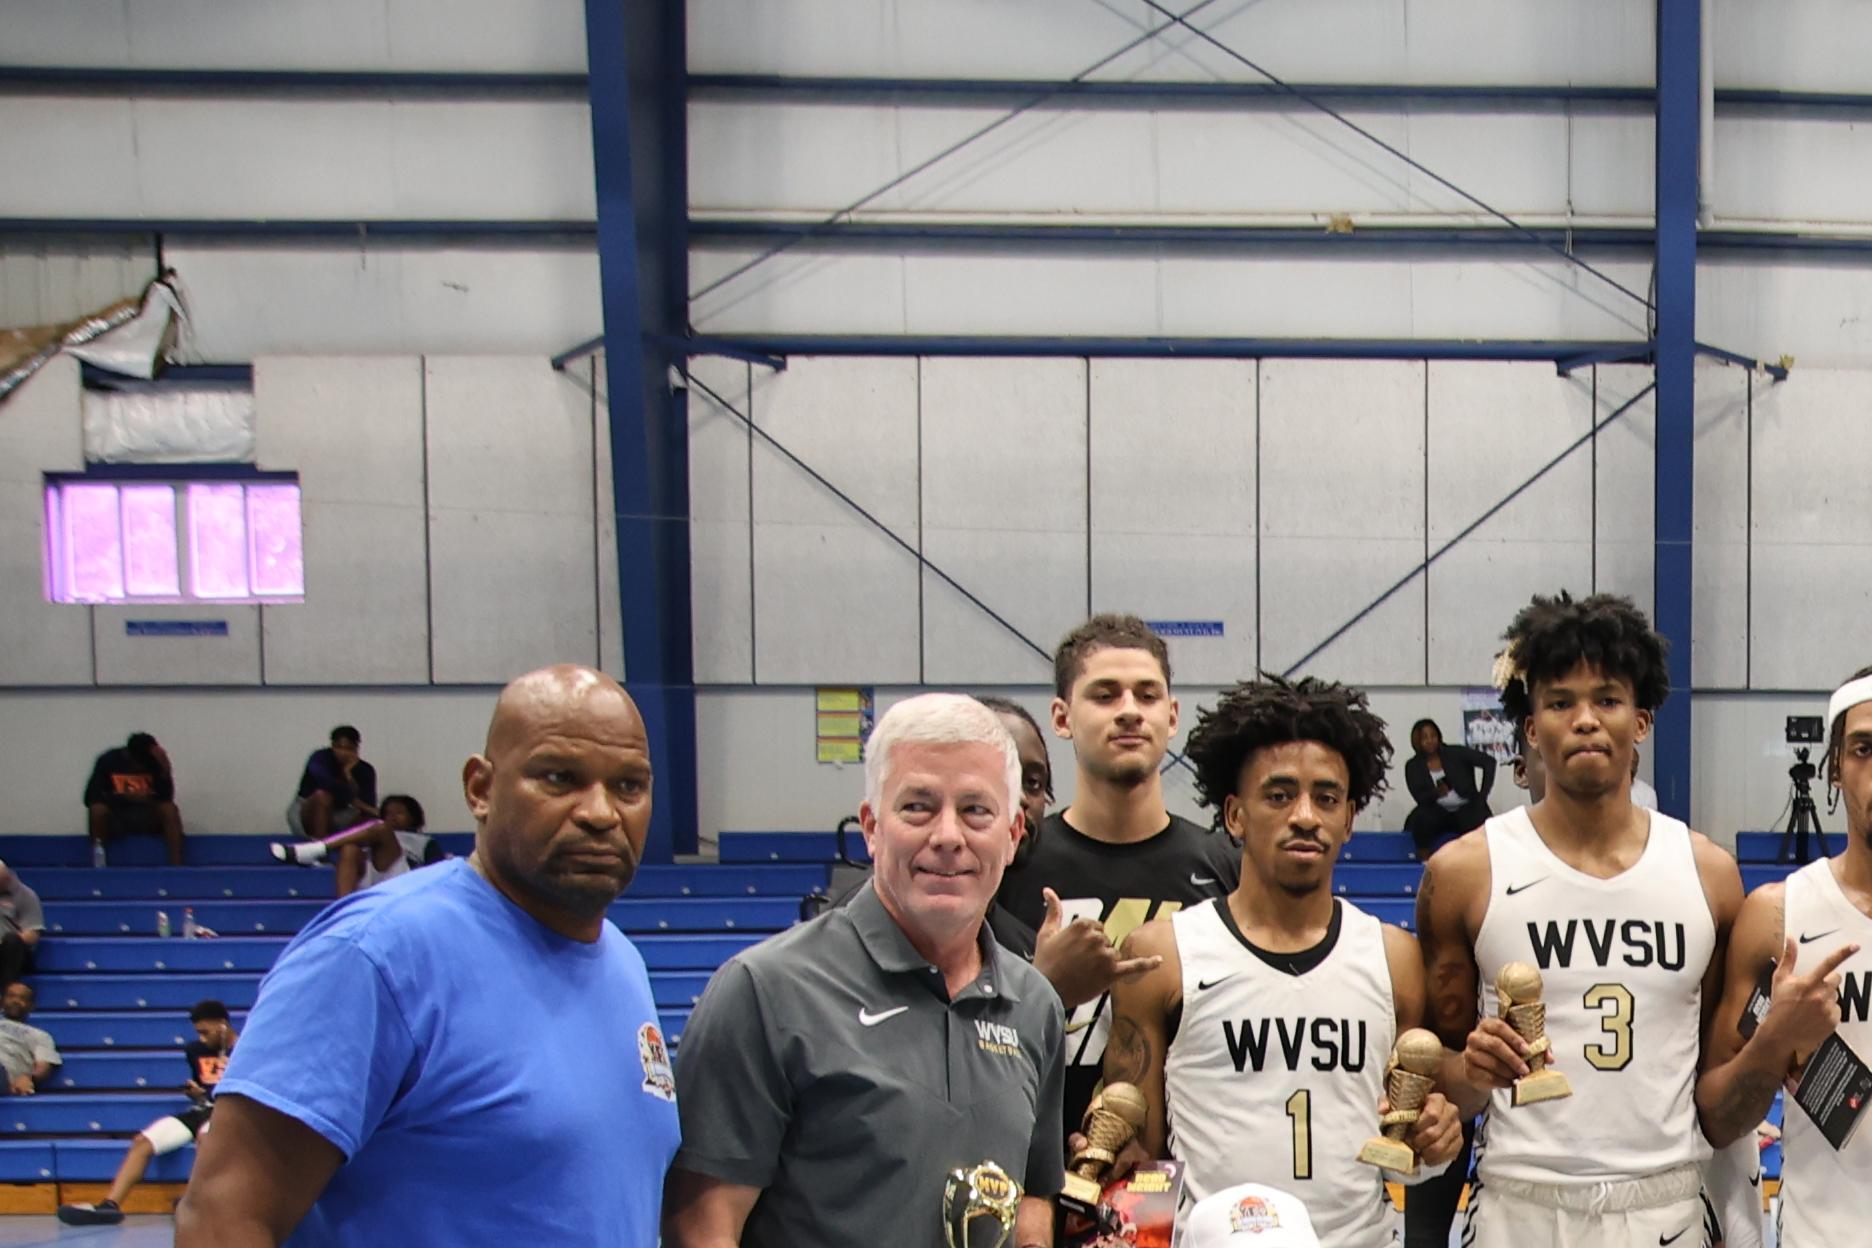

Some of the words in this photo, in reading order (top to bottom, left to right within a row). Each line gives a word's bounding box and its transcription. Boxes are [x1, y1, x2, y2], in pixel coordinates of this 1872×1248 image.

[1527, 919, 1686, 972] WVSU
[974, 1019, 1019, 1048] WVSU
[1222, 1017, 1366, 1072] WVSU
[1583, 983, 1635, 1071] 3
[1286, 1089, 1312, 1180] 1
[978, 1174, 1009, 1197] MVP
